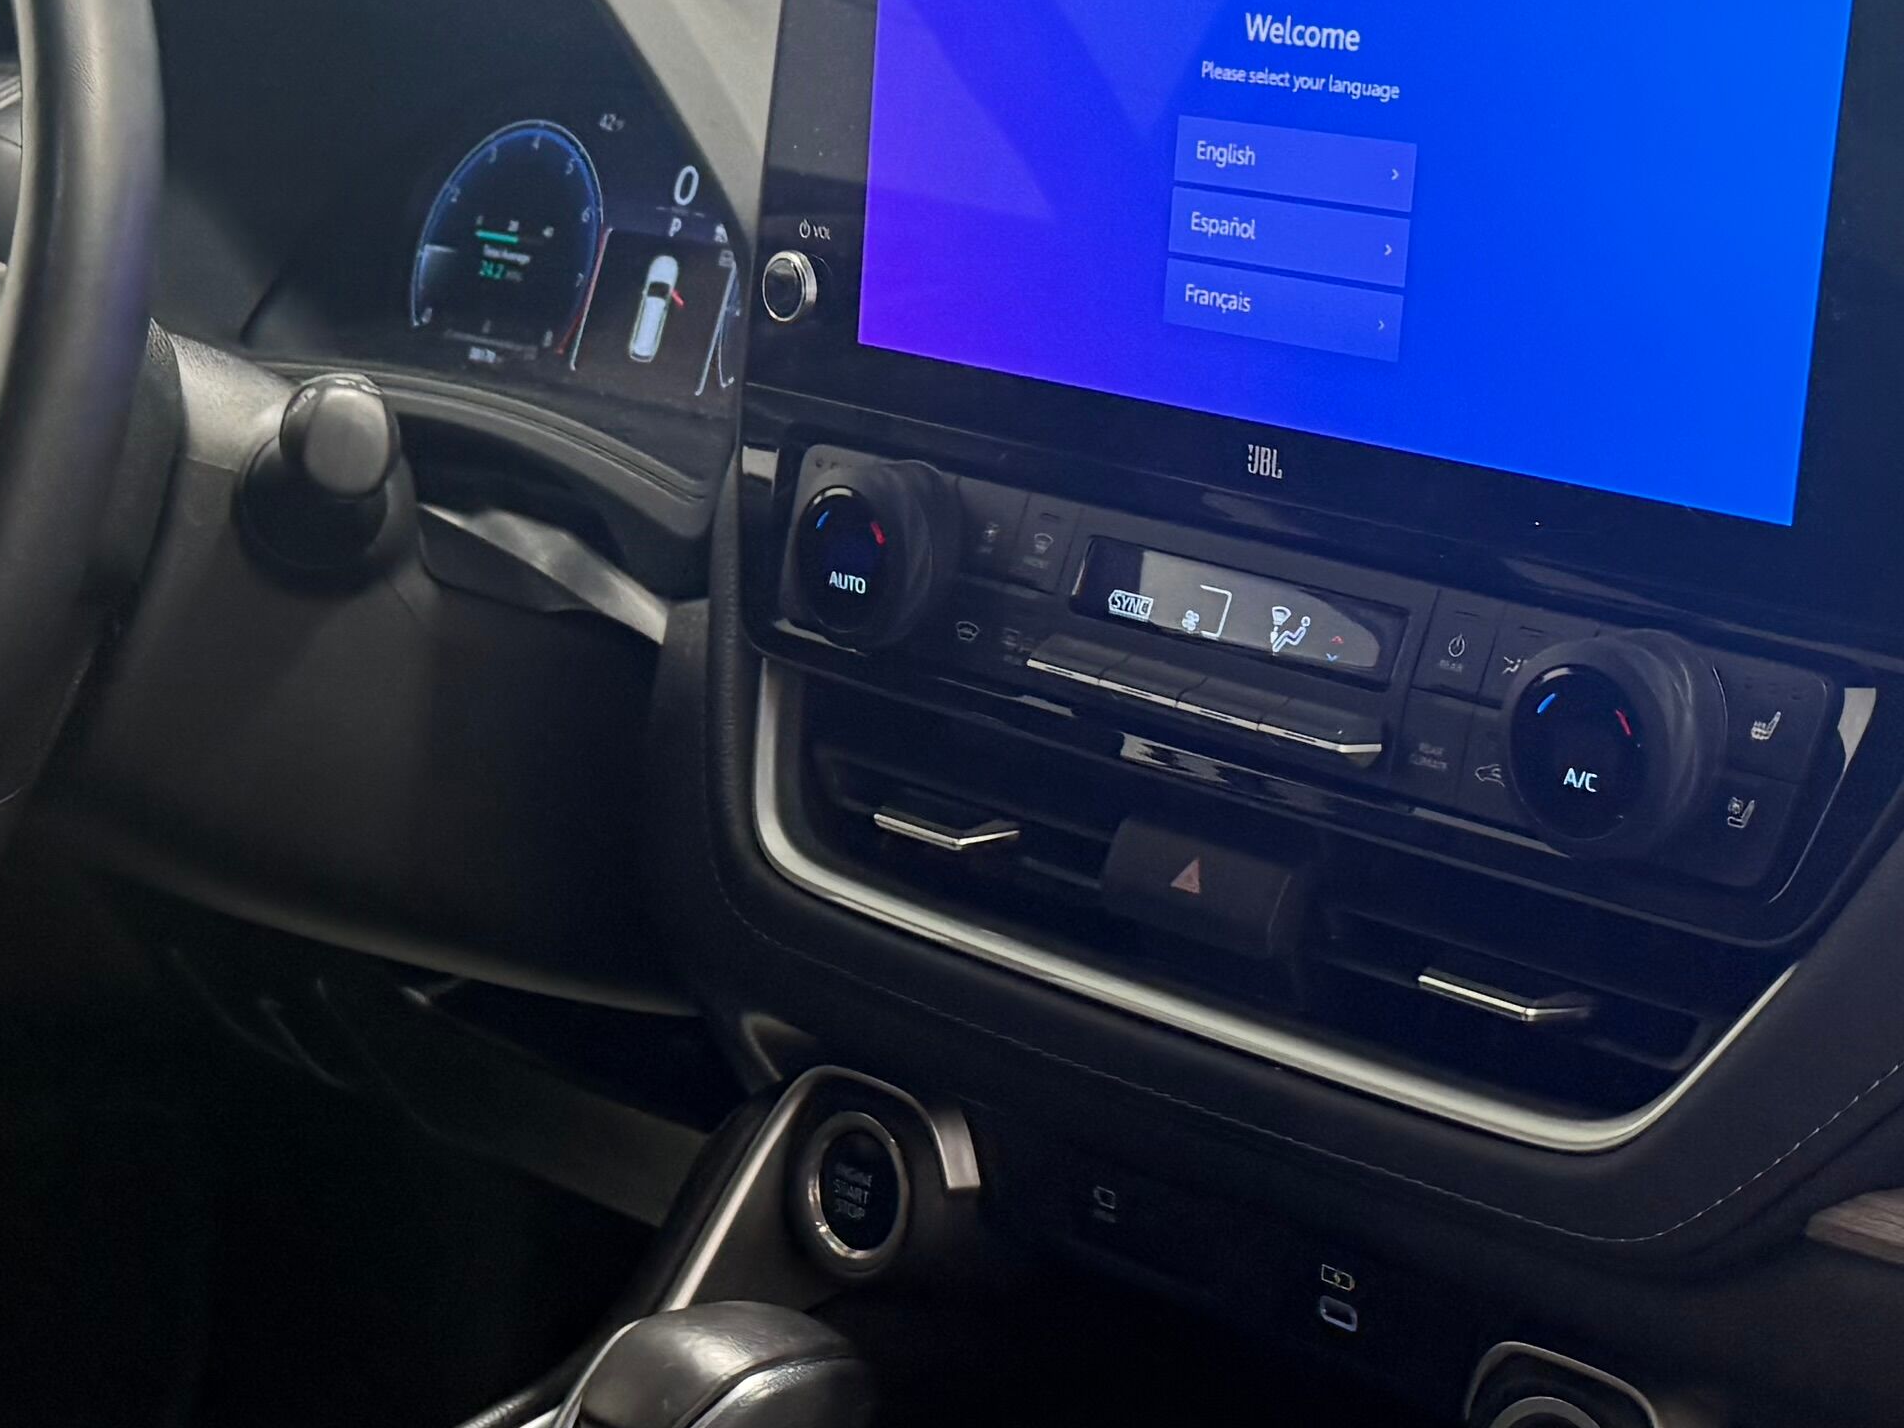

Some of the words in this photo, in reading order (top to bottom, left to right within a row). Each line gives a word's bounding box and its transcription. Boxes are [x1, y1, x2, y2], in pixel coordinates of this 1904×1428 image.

[1245, 12, 1361, 52] Welcome
[1201, 60, 1247, 83] Please
[1248, 67, 1290, 87] select
[1292, 74, 1326, 93] your
[1328, 74, 1400, 103] language
[1197, 140, 1256, 168] English
[673, 165, 700, 207] 0
[669, 218, 682, 237] P
[1191, 211, 1256, 240] Español
[1185, 283, 1251, 313] Français
[1247, 444, 1283, 479] JBL
[829, 571, 866, 595] AUTO
[1112, 592, 1151, 616] SYNC
[1563, 767, 1598, 793] A/C
